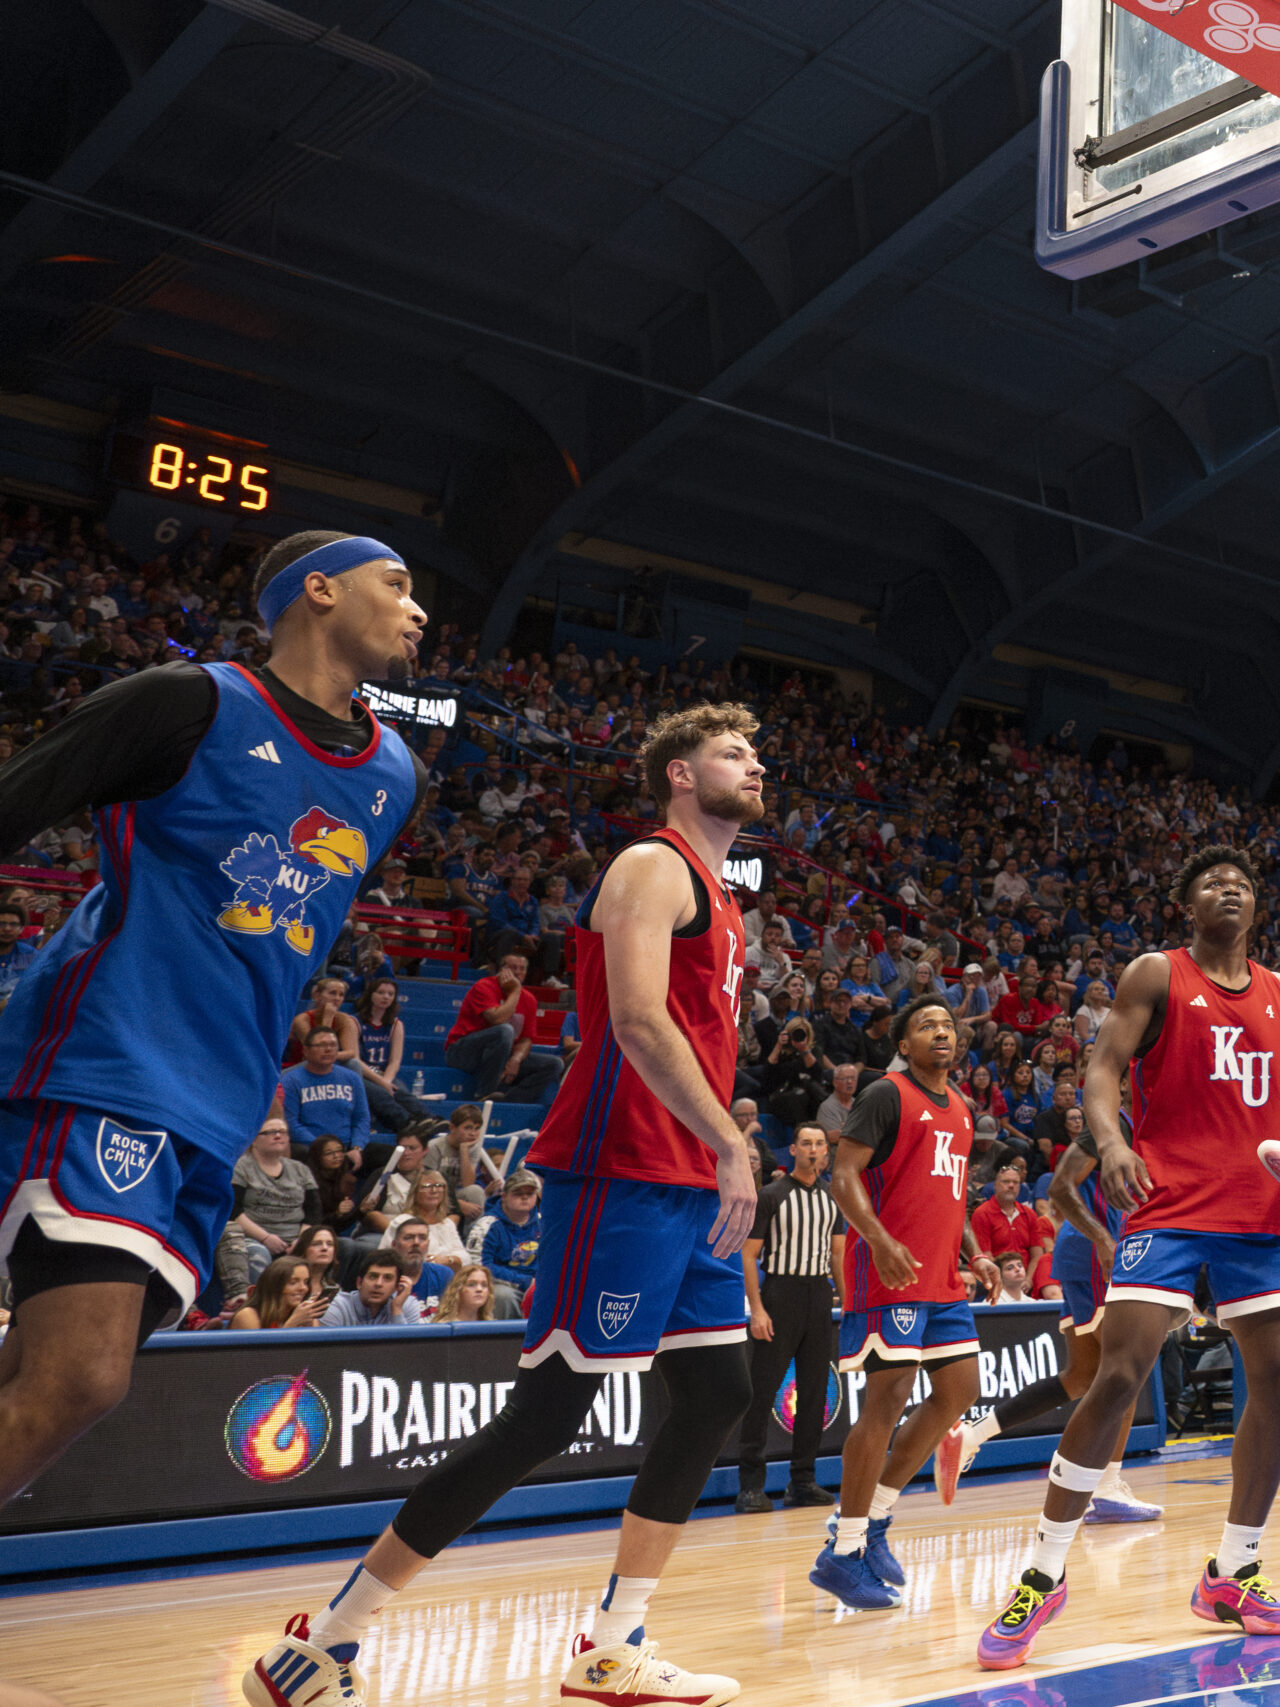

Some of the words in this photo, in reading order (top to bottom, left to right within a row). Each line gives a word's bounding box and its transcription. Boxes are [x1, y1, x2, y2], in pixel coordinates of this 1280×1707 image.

[150, 443, 268, 510] 8:25
[155, 518, 181, 543] 6
[361, 682, 416, 714] PRAIRIE
[418, 698, 457, 727] BAND
[1060, 719, 1076, 739] 8
[371, 789, 387, 816] 3
[276, 864, 309, 894] KU
[722, 857, 763, 892] BAND
[1265, 1005, 1275, 1019] 4
[368, 1047, 385, 1063] 11
[1209, 1025, 1274, 1108] KU
[301, 1084, 353, 1104] KANSAS
[111, 1133, 148, 1156] ROCK
[104, 1147, 147, 1179] CHALK
[930, 1130, 967, 1201] KU
[1127, 1241, 1144, 1249] ROCK
[606, 1302, 631, 1311] ROCK
[602, 1311, 629, 1329] CHALK
[978, 1332, 1058, 1398] BAND
[405, 1450, 457, 1470] CAS
